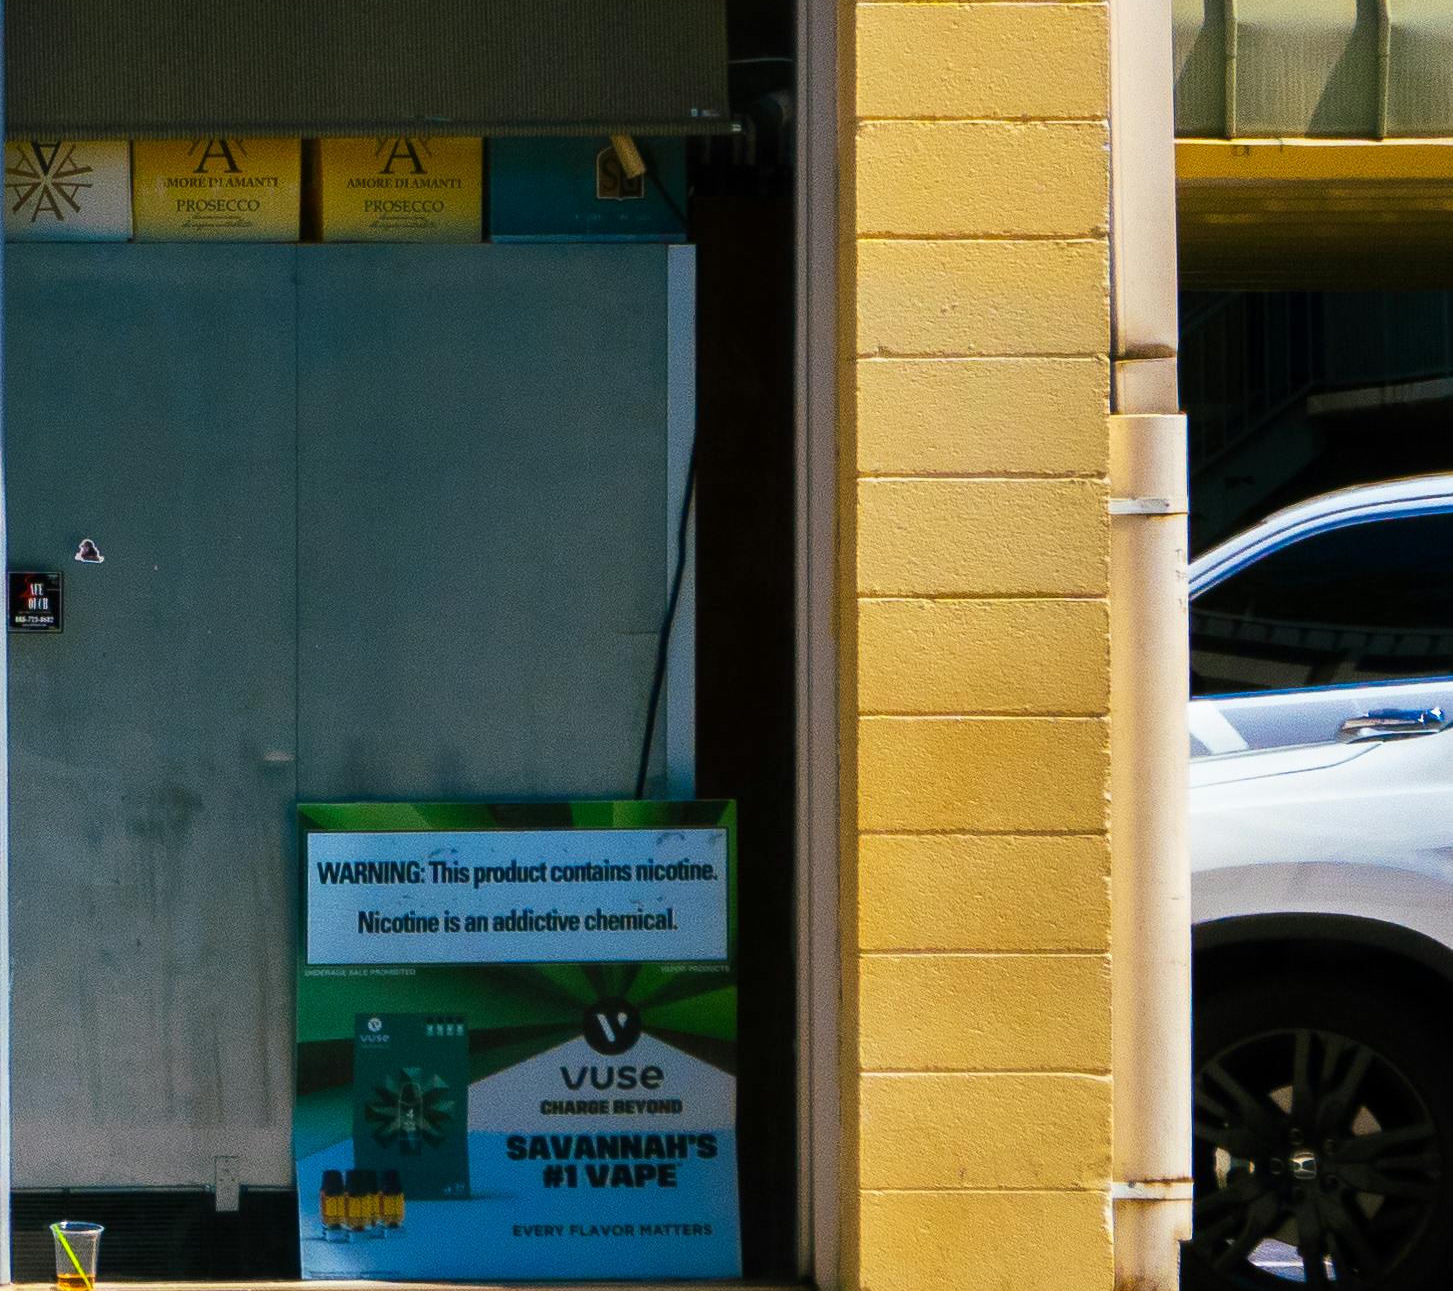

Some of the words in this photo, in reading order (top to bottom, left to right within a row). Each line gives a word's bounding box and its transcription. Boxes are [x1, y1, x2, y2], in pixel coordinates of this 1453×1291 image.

[346, 177, 393, 189] AMORE
[396, 177, 409, 189] DI
[412, 177, 462, 189] AMANTI
[176, 198, 260, 213] PROSECCO
[363, 199, 444, 213] PROSECCO
[317, 861, 426, 885] WARNING:
[430, 861, 469, 883] This
[473, 861, 547, 889] product
[550, 861, 632, 883] contains
[636, 860, 718, 882] nicotine.
[358, 911, 440, 935] Nicotine
[444, 912, 461, 934] is
[465, 915, 489, 933] an
[492, 909, 580, 933] addictive
[584, 909, 677, 932] chemical.
[540, 1099, 608, 1115] CHARGE
[612, 1099, 683, 1115] BEYOND
[506, 1133, 718, 1161] SAVANNAH'S
[542, 1164, 578, 1188] #1
[585, 1164, 677, 1188] VAPE
[513, 1223, 564, 1237] EVERY
[569, 1223, 635, 1237] FLAVOR
[639, 1222, 713, 1237] MATTERS
